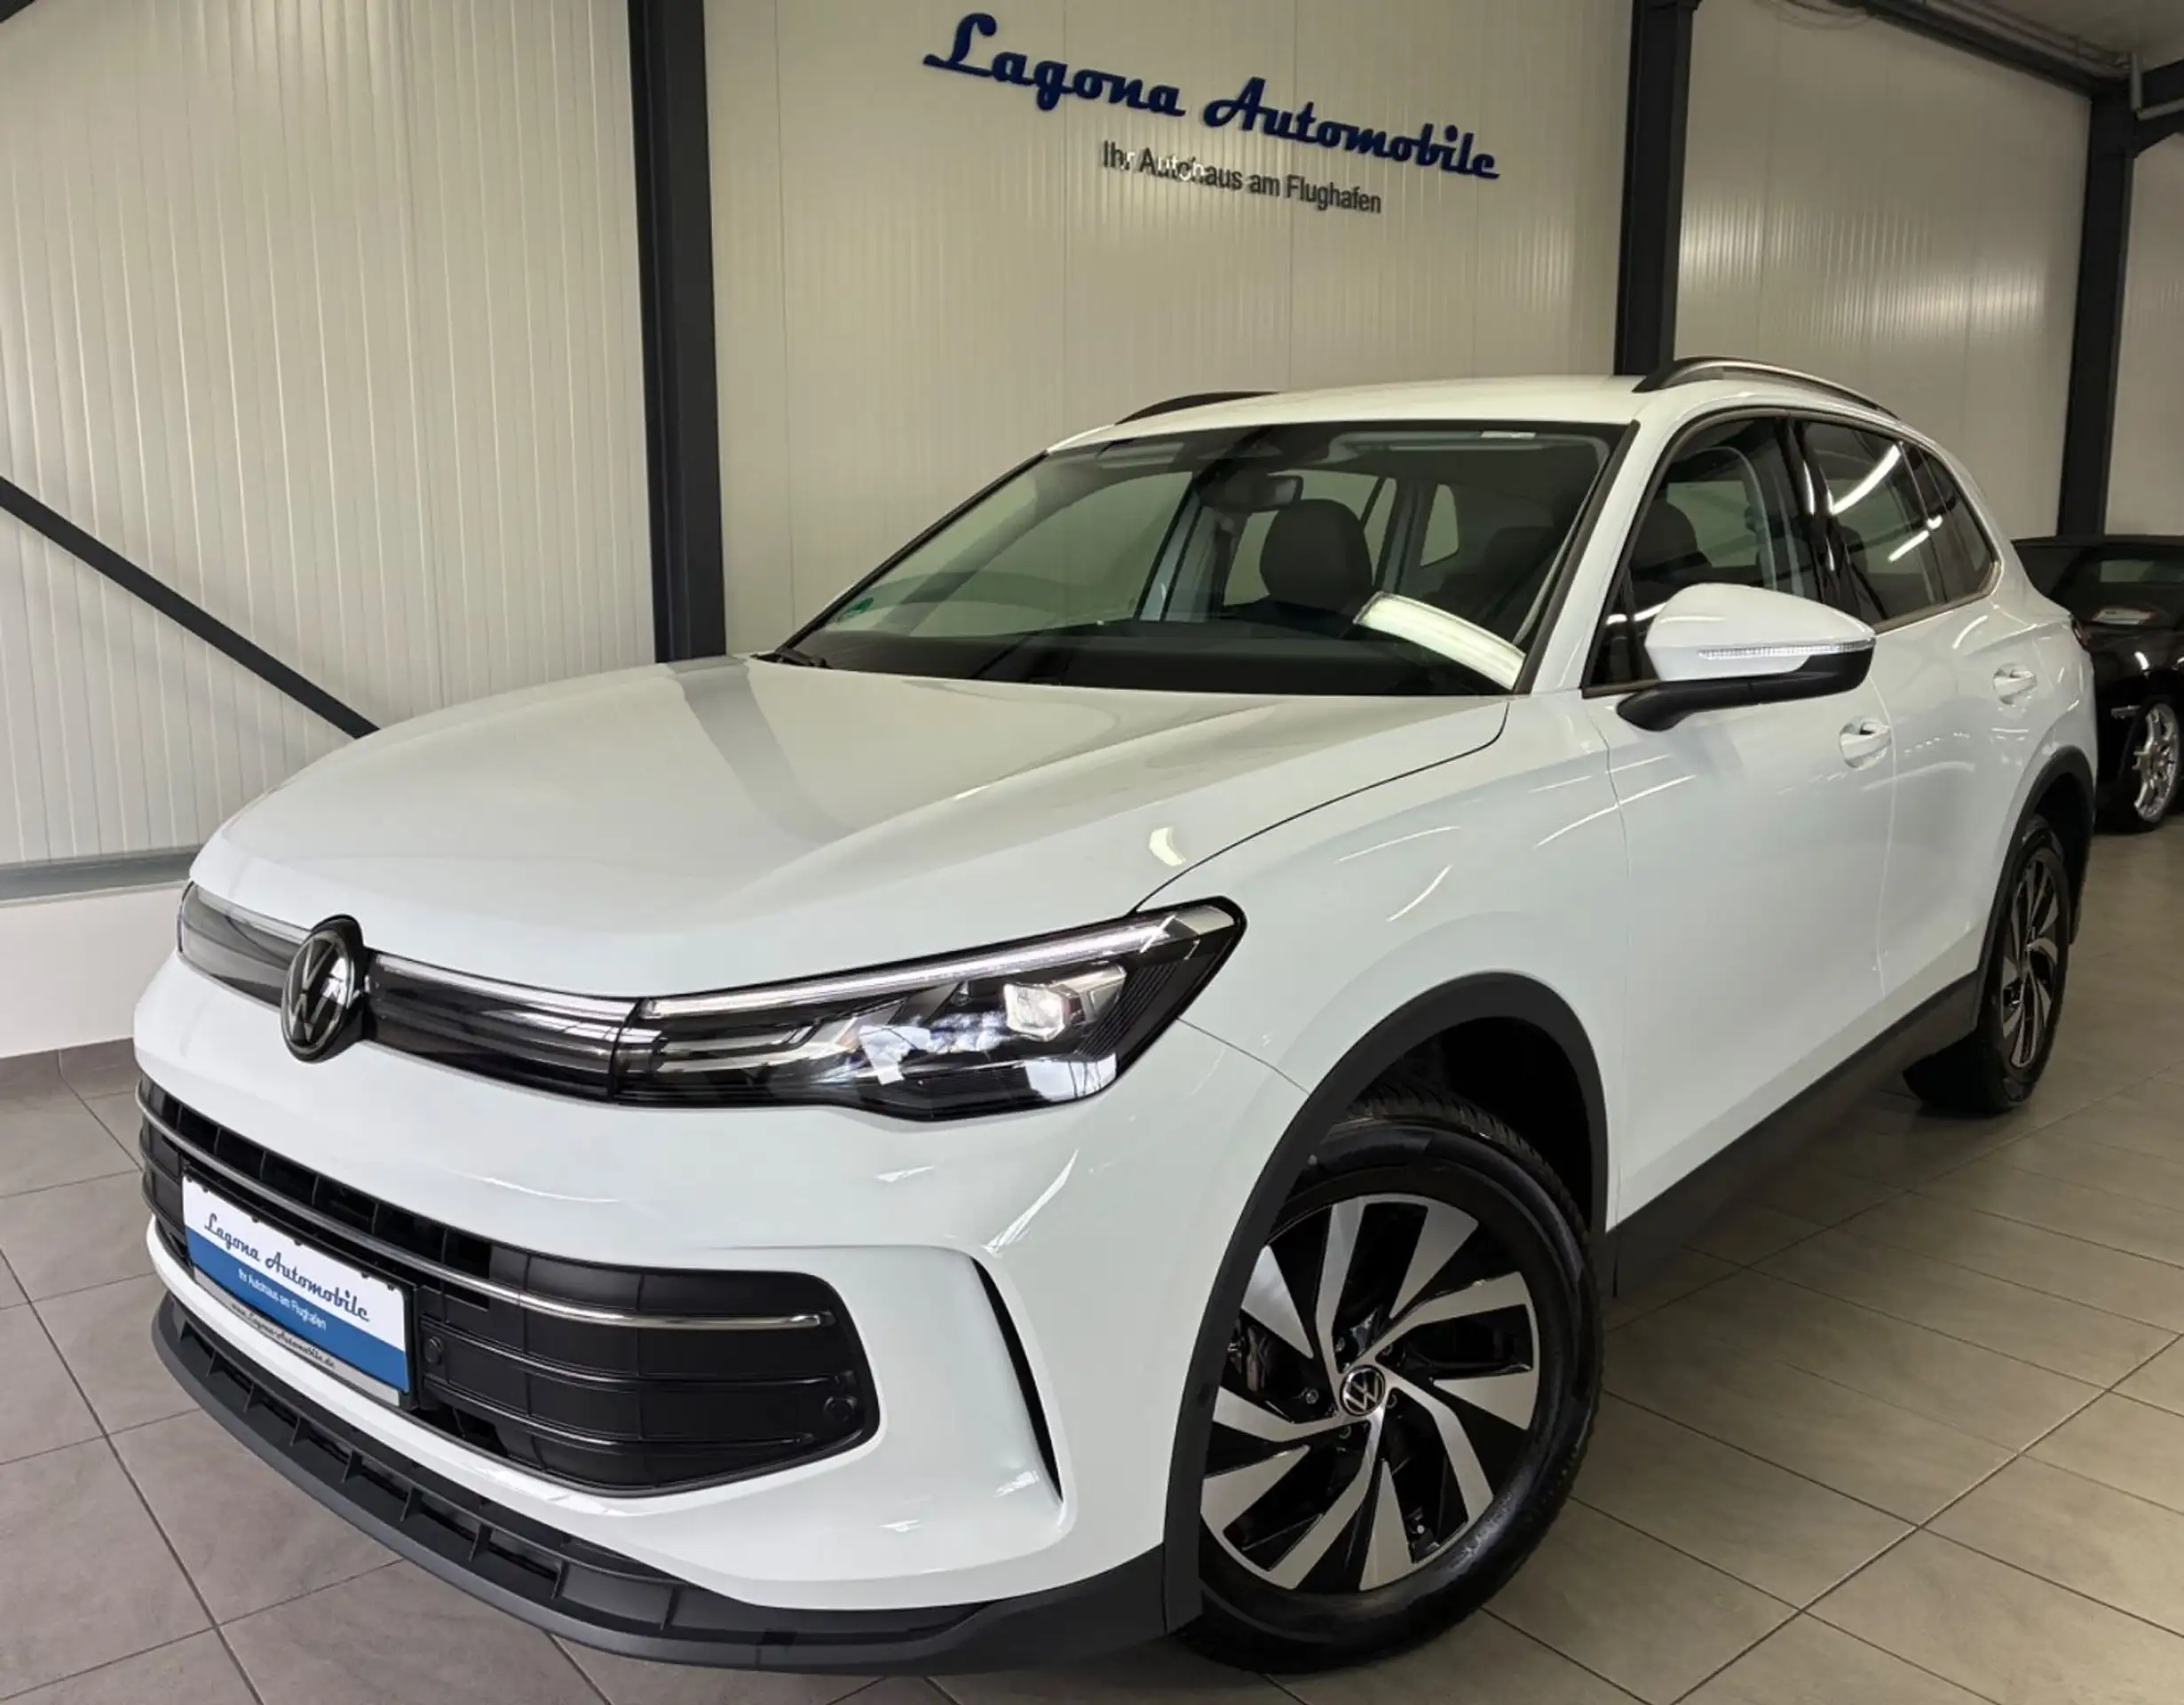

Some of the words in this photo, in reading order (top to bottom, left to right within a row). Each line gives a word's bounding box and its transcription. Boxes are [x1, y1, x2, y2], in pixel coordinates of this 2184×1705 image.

[922, 12, 1186, 116] Lagona
[1202, 77, 1500, 179] Automobile
[1103, 140, 1136, 170] Ihr
[1140, 147, 1243, 190] Autohaus
[1248, 173, 1280, 196] am
[1287, 175, 1381, 213] Flughafen
[204, 1212, 260, 1262] Lagona
[265, 1252, 369, 1322] Automobile
